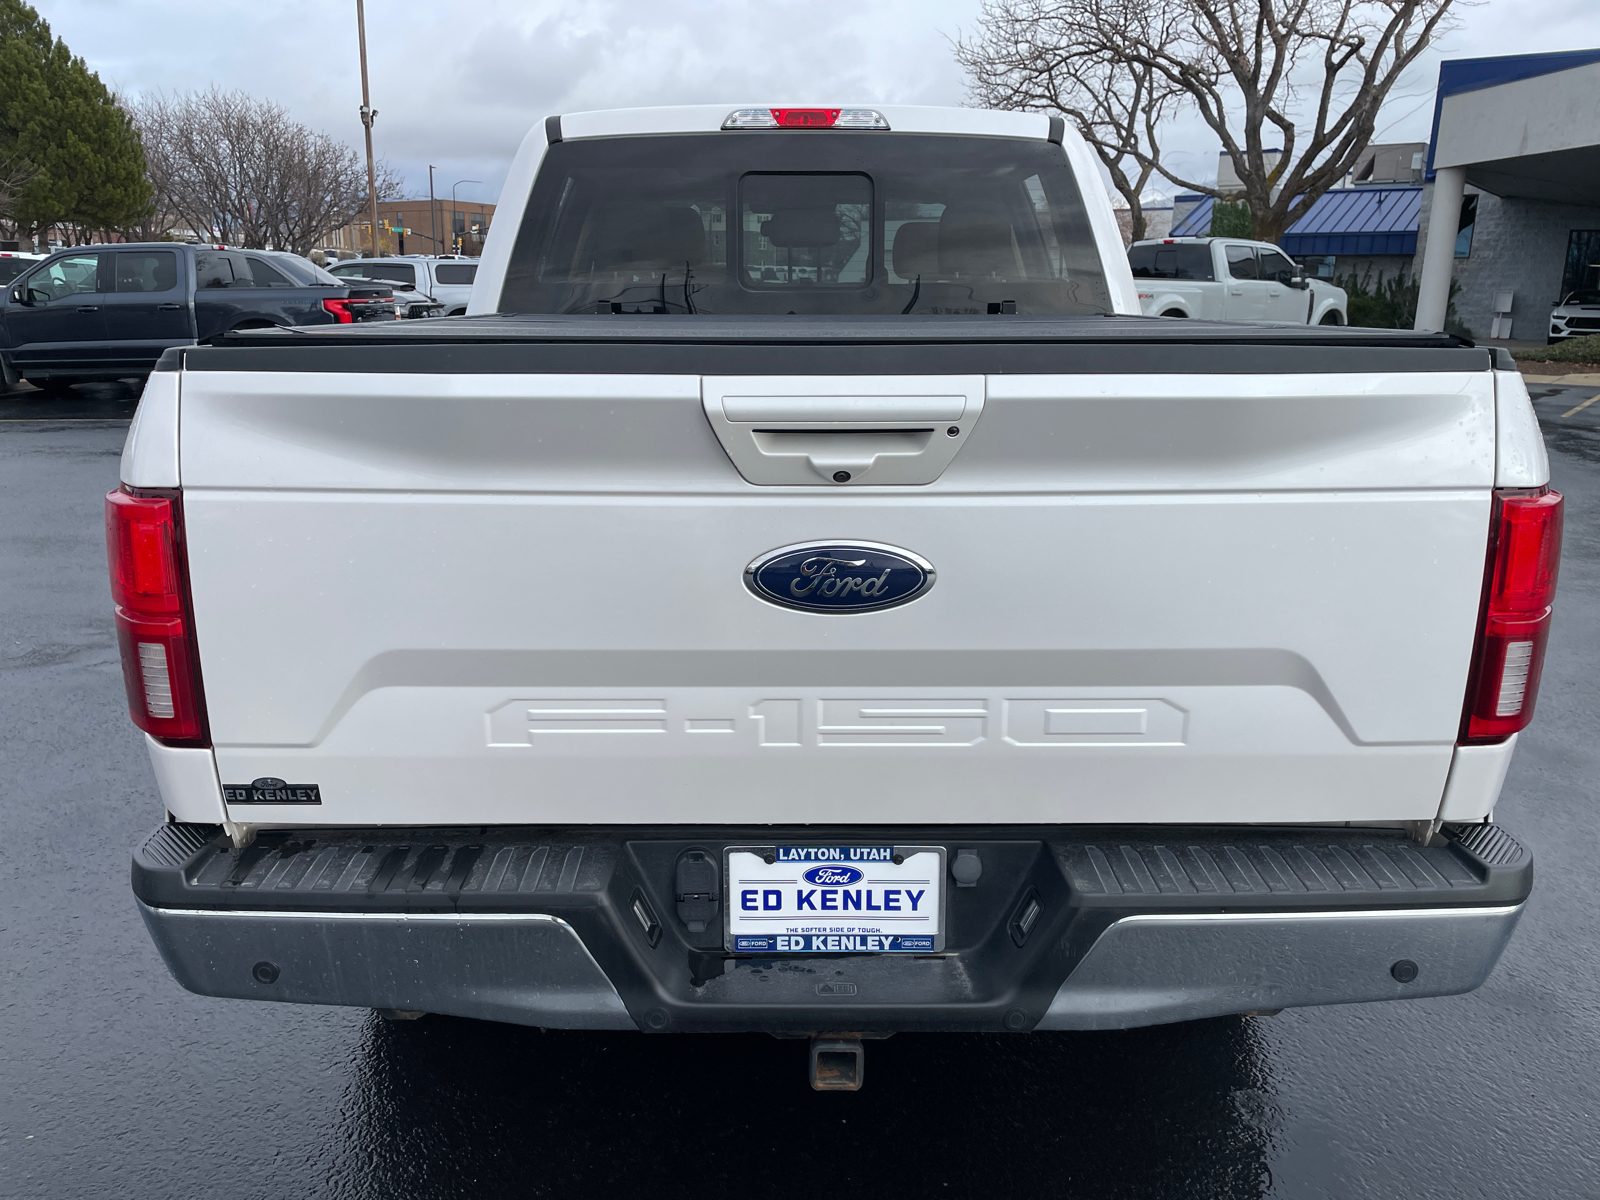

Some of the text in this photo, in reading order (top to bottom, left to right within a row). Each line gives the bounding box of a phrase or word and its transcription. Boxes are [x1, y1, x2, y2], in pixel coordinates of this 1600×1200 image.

[790, 557, 891, 597] Ford
[485, 698, 1189, 748] F-150
[260, 779, 278, 788] Ford
[225, 789, 318, 800] ED KENLEY
[779, 848, 891, 861] LAYTON, UTAH
[815, 868, 851, 884] Ford
[741, 889, 926, 911] ED KENLEY
[776, 936, 804, 950] ED
[811, 936, 894, 950] KENLEY
